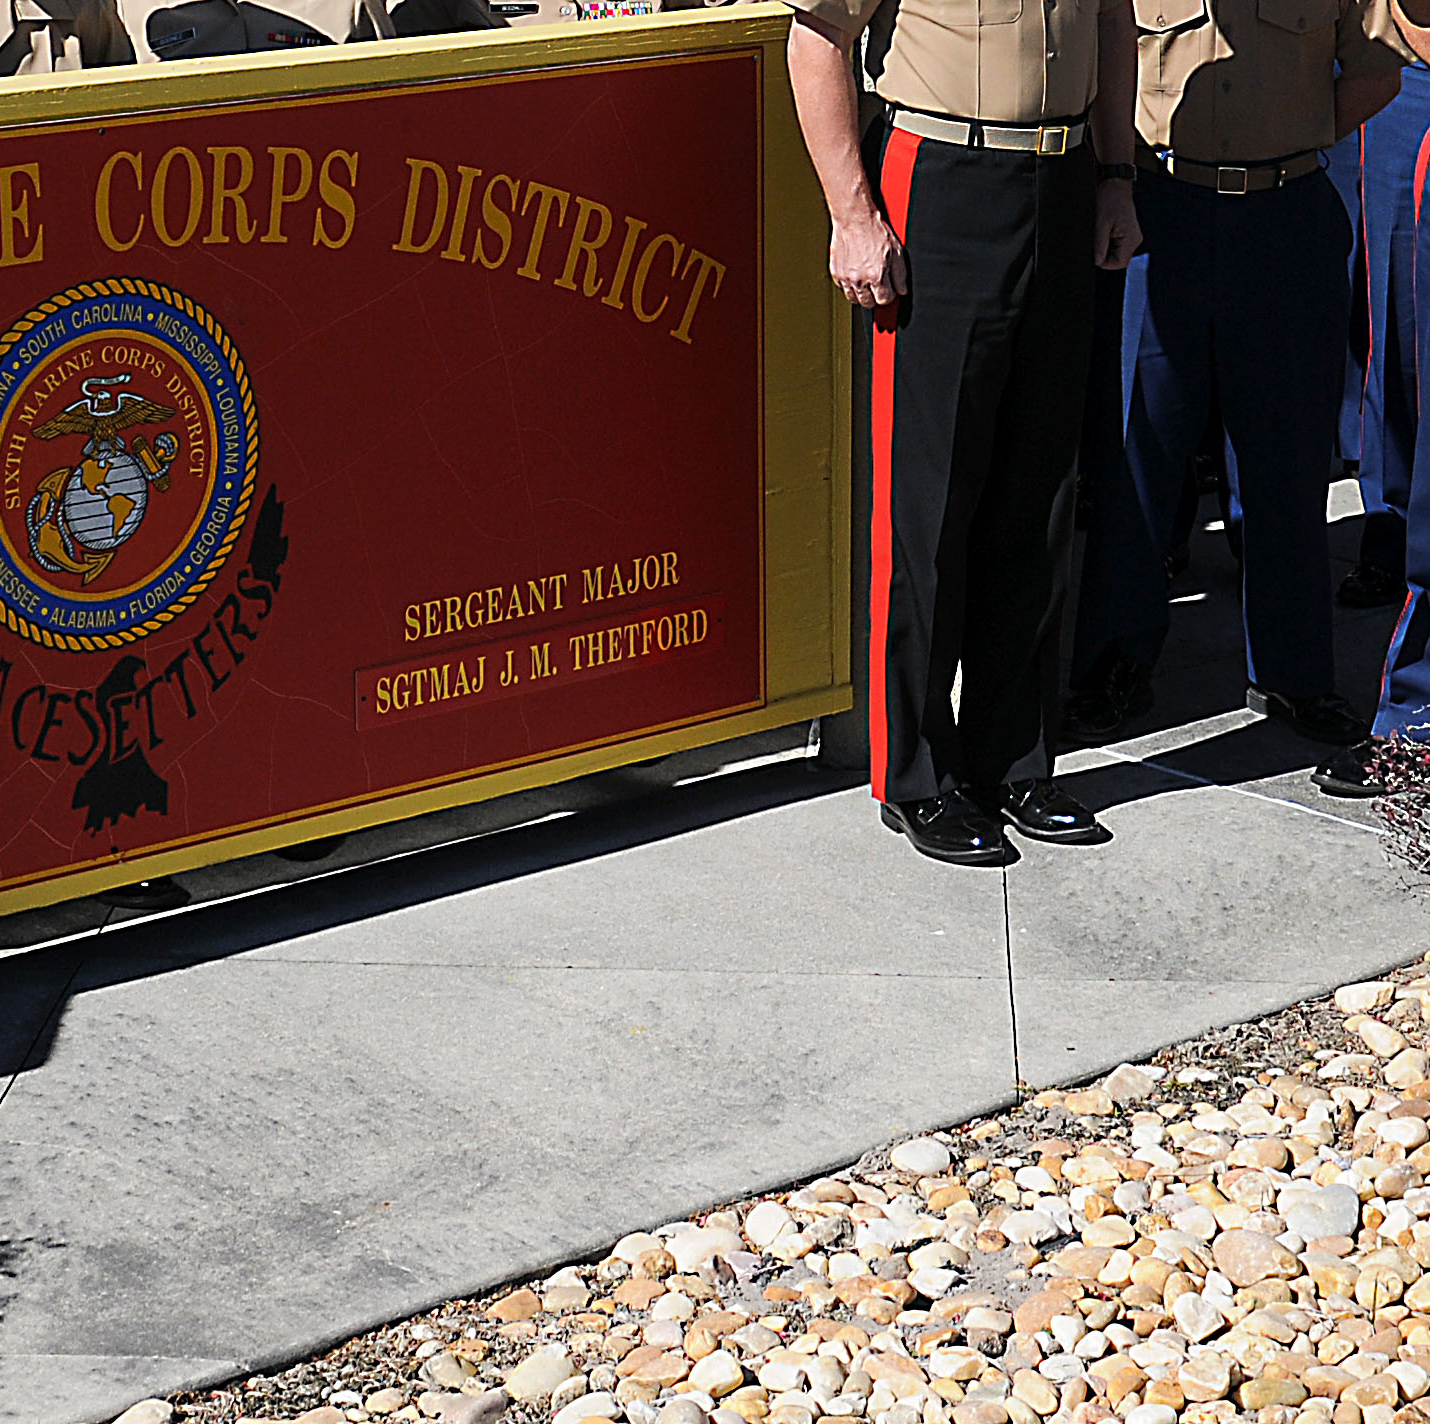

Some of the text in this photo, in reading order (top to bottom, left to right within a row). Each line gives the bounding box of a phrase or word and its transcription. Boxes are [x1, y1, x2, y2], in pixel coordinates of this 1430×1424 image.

[94, 146, 360, 252] CORPS
[391, 157, 727, 345] DISTRICT
[19, 319, 66, 364] SOUTH
[71, 303, 142, 329] CAROLINA
[155, 311, 222, 380] MISSISSIPPI
[5, 345, 205, 510] SIXTH MARINE CORPS DISTRICT
[216, 387, 238, 475] LOUISIANA
[190, 496, 232, 565] GEORGIA
[49, 608, 116, 629] ALABAMA
[129, 571, 186, 619] FLORIDA
[404, 551, 680, 643] SERGEANT MAJOR
[376, 609, 708, 714] SGTMAJ J. M. THETFORD
